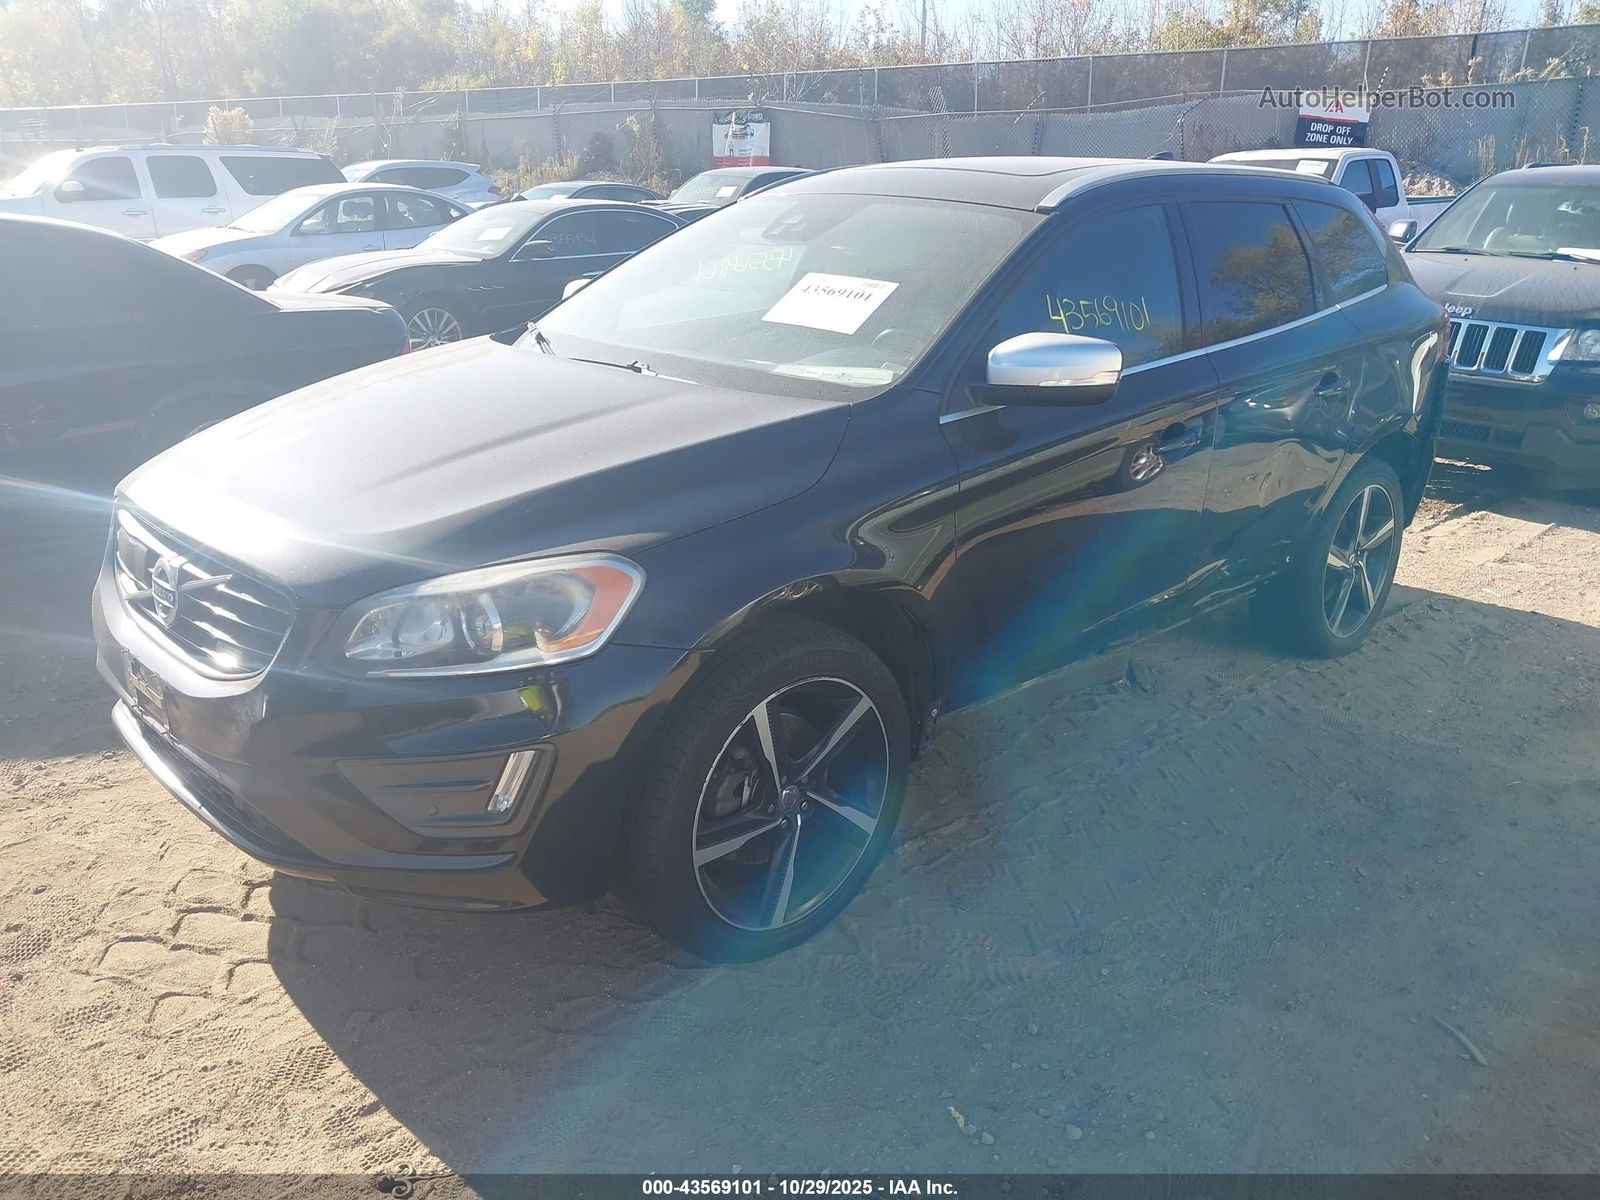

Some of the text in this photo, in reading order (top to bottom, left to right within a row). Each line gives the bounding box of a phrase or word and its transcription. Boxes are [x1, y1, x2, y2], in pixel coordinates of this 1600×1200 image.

[1310, 122, 1352, 135] DROP OFF
[1305, 132, 1354, 145] ZONE ONLY
[800, 284, 874, 302] 43569101
[1046, 294, 1150, 334] 43569101
